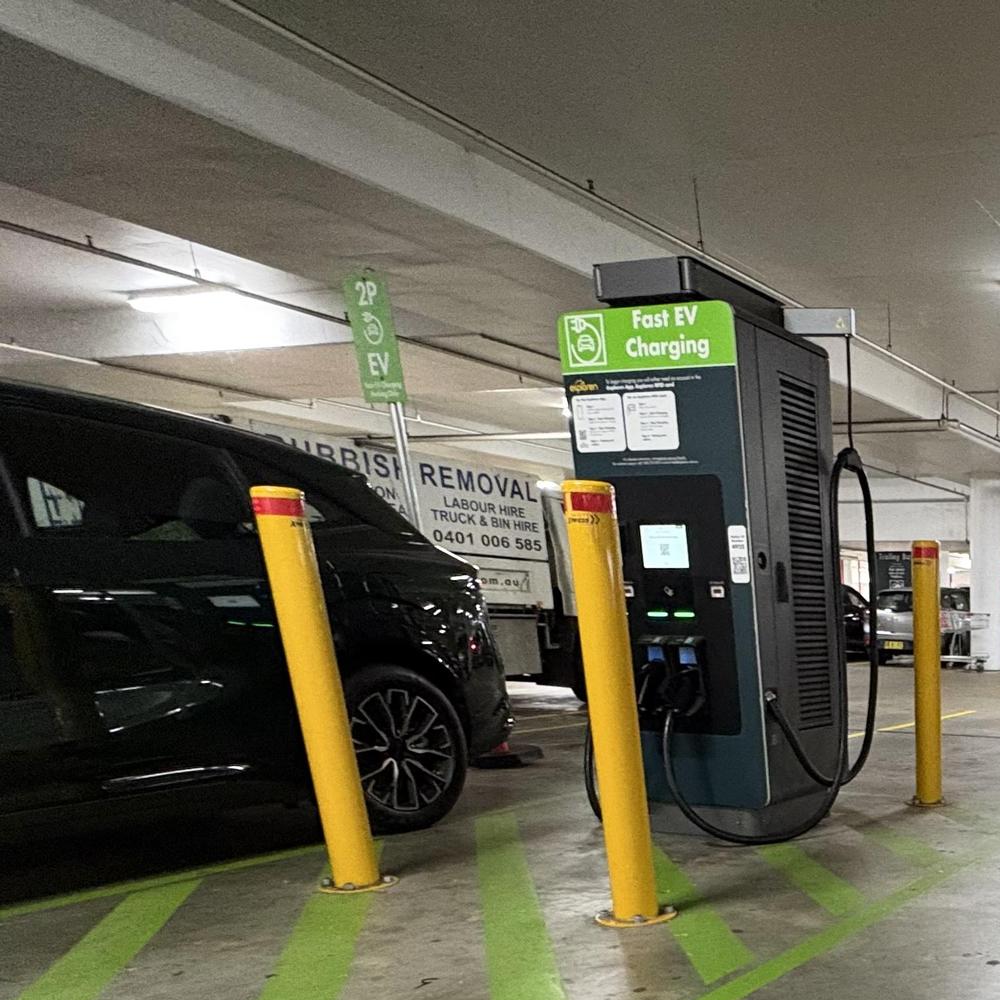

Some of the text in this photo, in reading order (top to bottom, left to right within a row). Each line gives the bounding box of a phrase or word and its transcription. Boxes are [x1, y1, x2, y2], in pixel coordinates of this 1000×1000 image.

[355, 281, 377, 306] 2P
[632, 305, 698, 330] Fast EV
[625, 334, 710, 361] Charging
[367, 352, 389, 376] EV
[419, 463, 538, 503] REMOVAL
[443, 496, 526, 519] LABOUR HIRE
[431, 508, 540, 533] TRUCK & BIN HIRE
[433, 529, 542, 552] 0401 006 585
